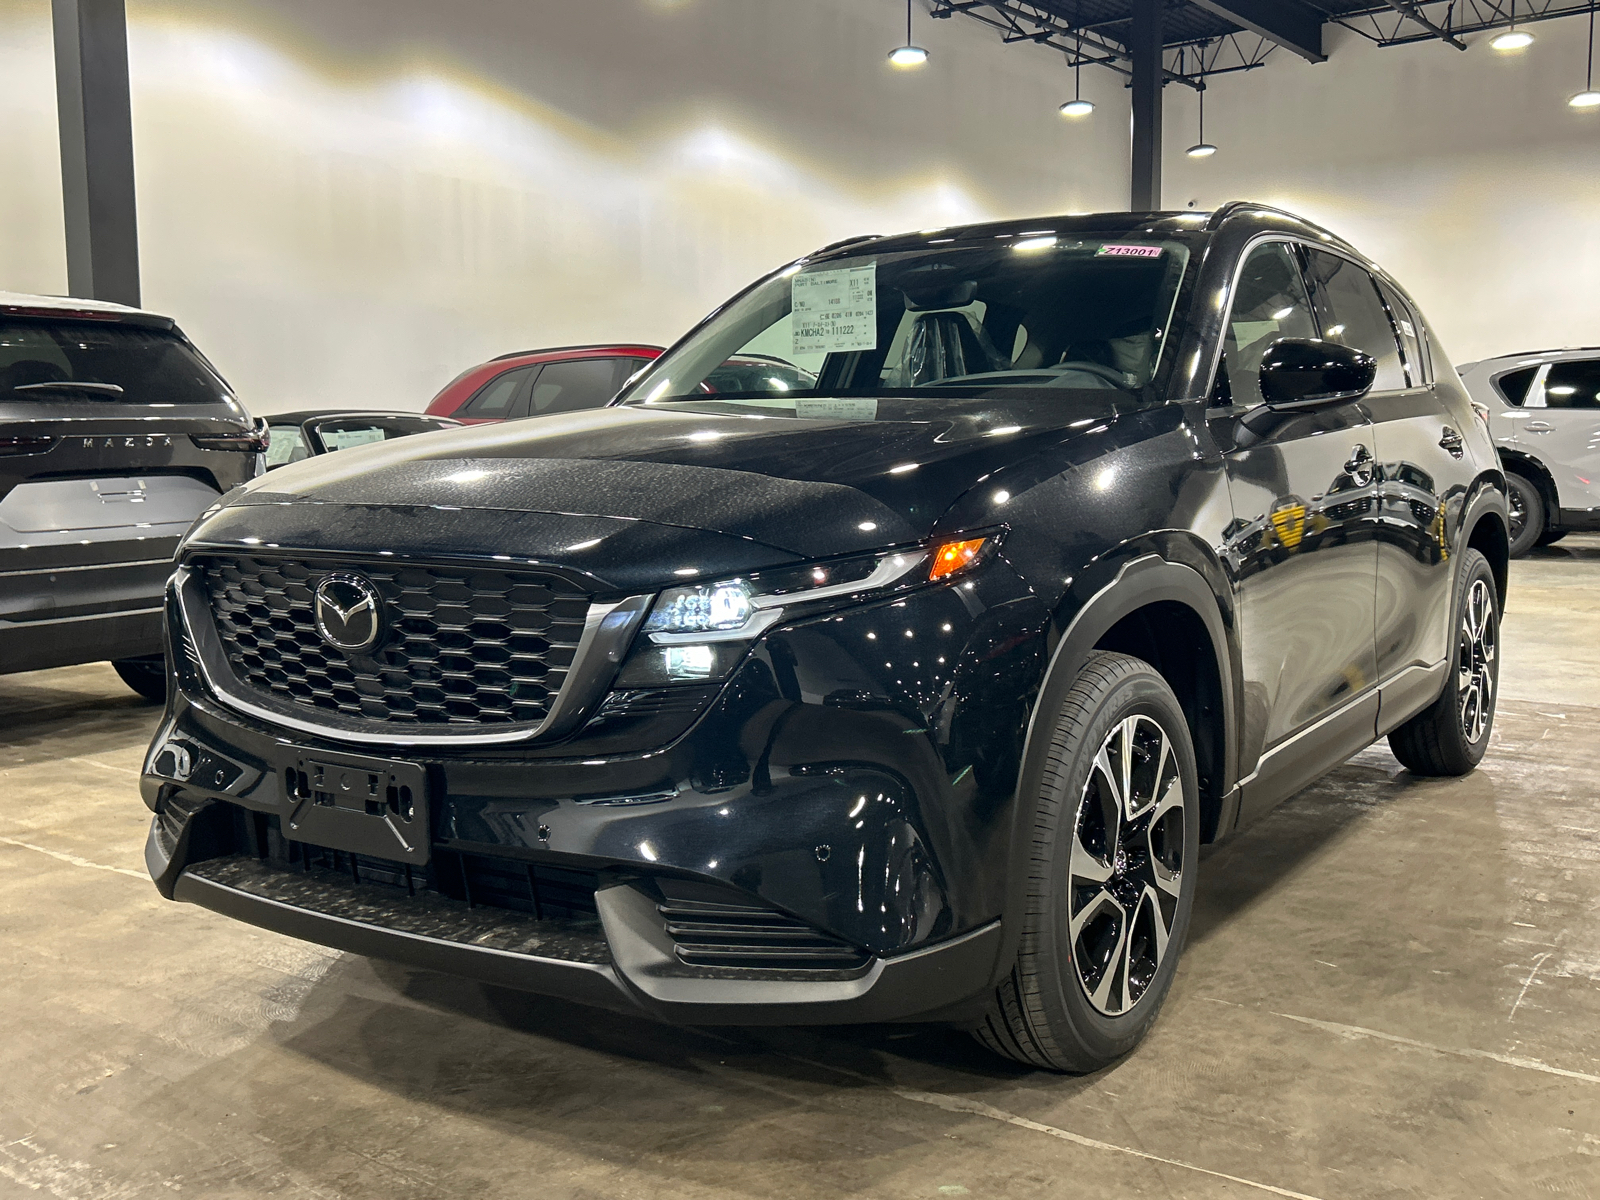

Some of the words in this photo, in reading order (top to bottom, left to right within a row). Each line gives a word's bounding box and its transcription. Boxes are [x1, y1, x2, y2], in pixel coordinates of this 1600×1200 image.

[1105, 247, 1153, 255] Z13001
[801, 327, 824, 337] KMCHA2
[832, 325, 854, 336] 111222
